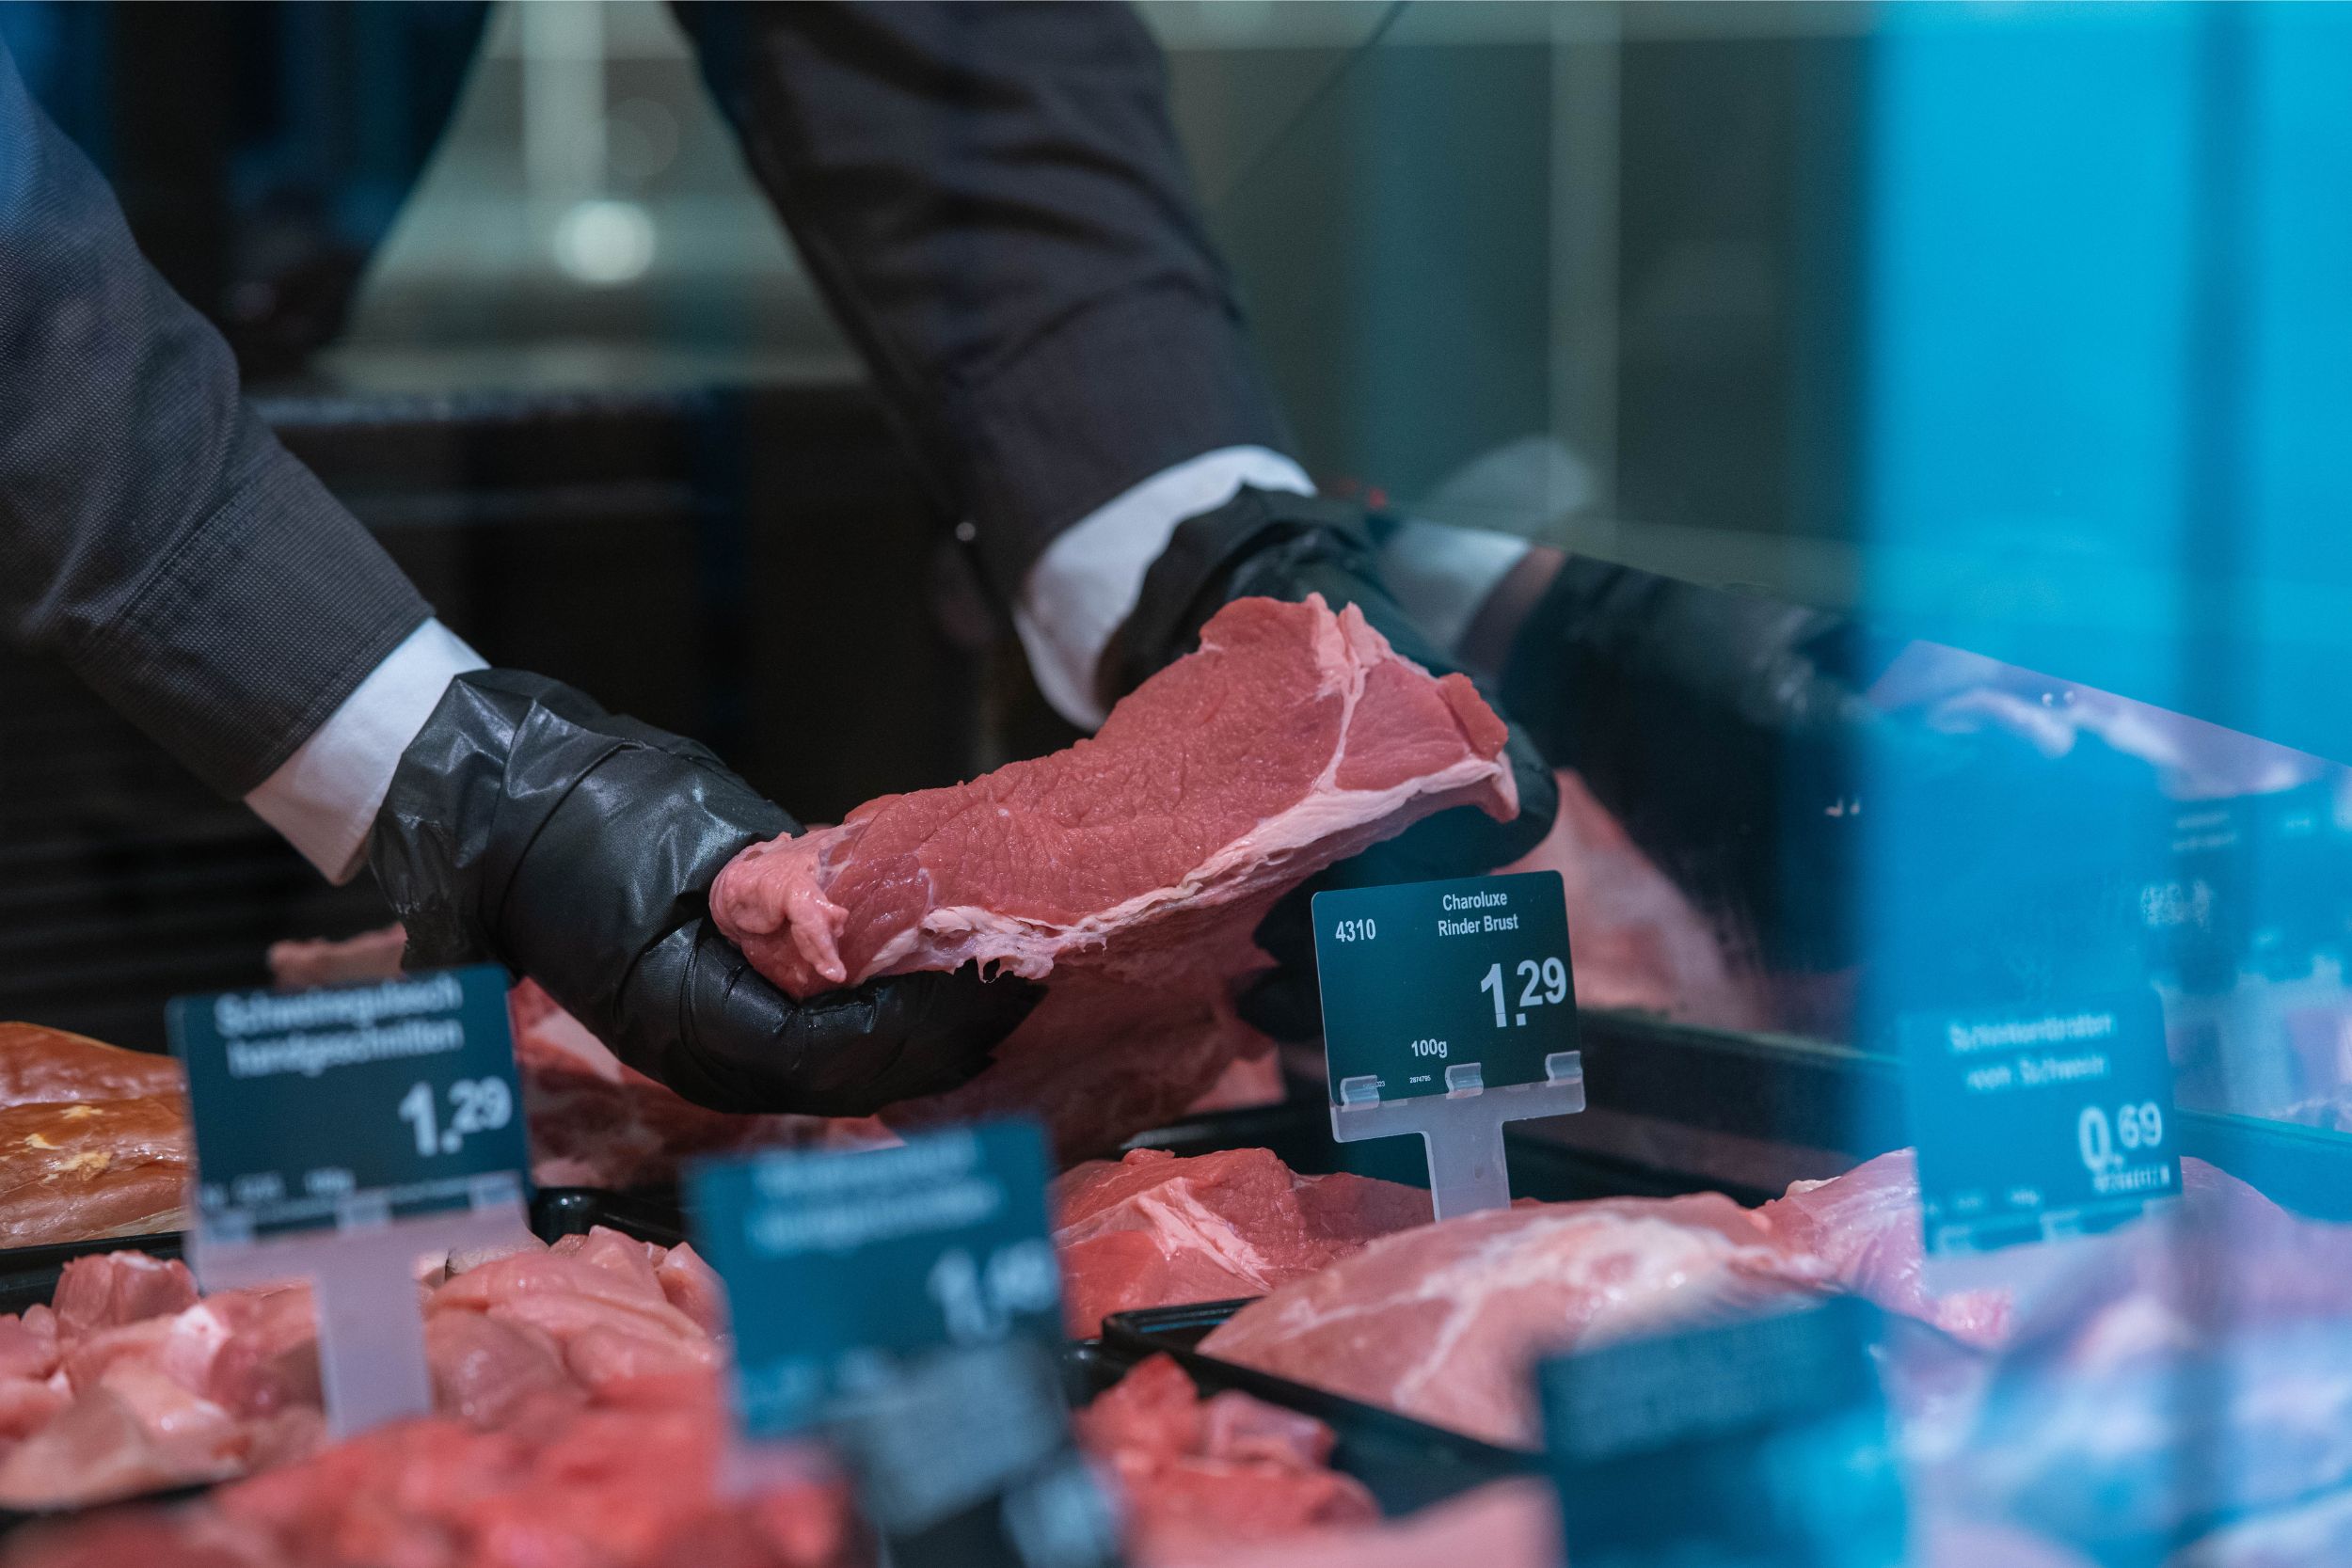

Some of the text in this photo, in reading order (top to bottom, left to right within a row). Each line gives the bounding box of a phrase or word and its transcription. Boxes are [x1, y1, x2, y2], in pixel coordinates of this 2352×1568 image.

[1442, 891, 1507, 911] Charoluxe
[1335, 918, 1376, 942] 4310
[1438, 913, 1518, 937] Rinder Brust
[1411, 1038, 1448, 1058] 100g
